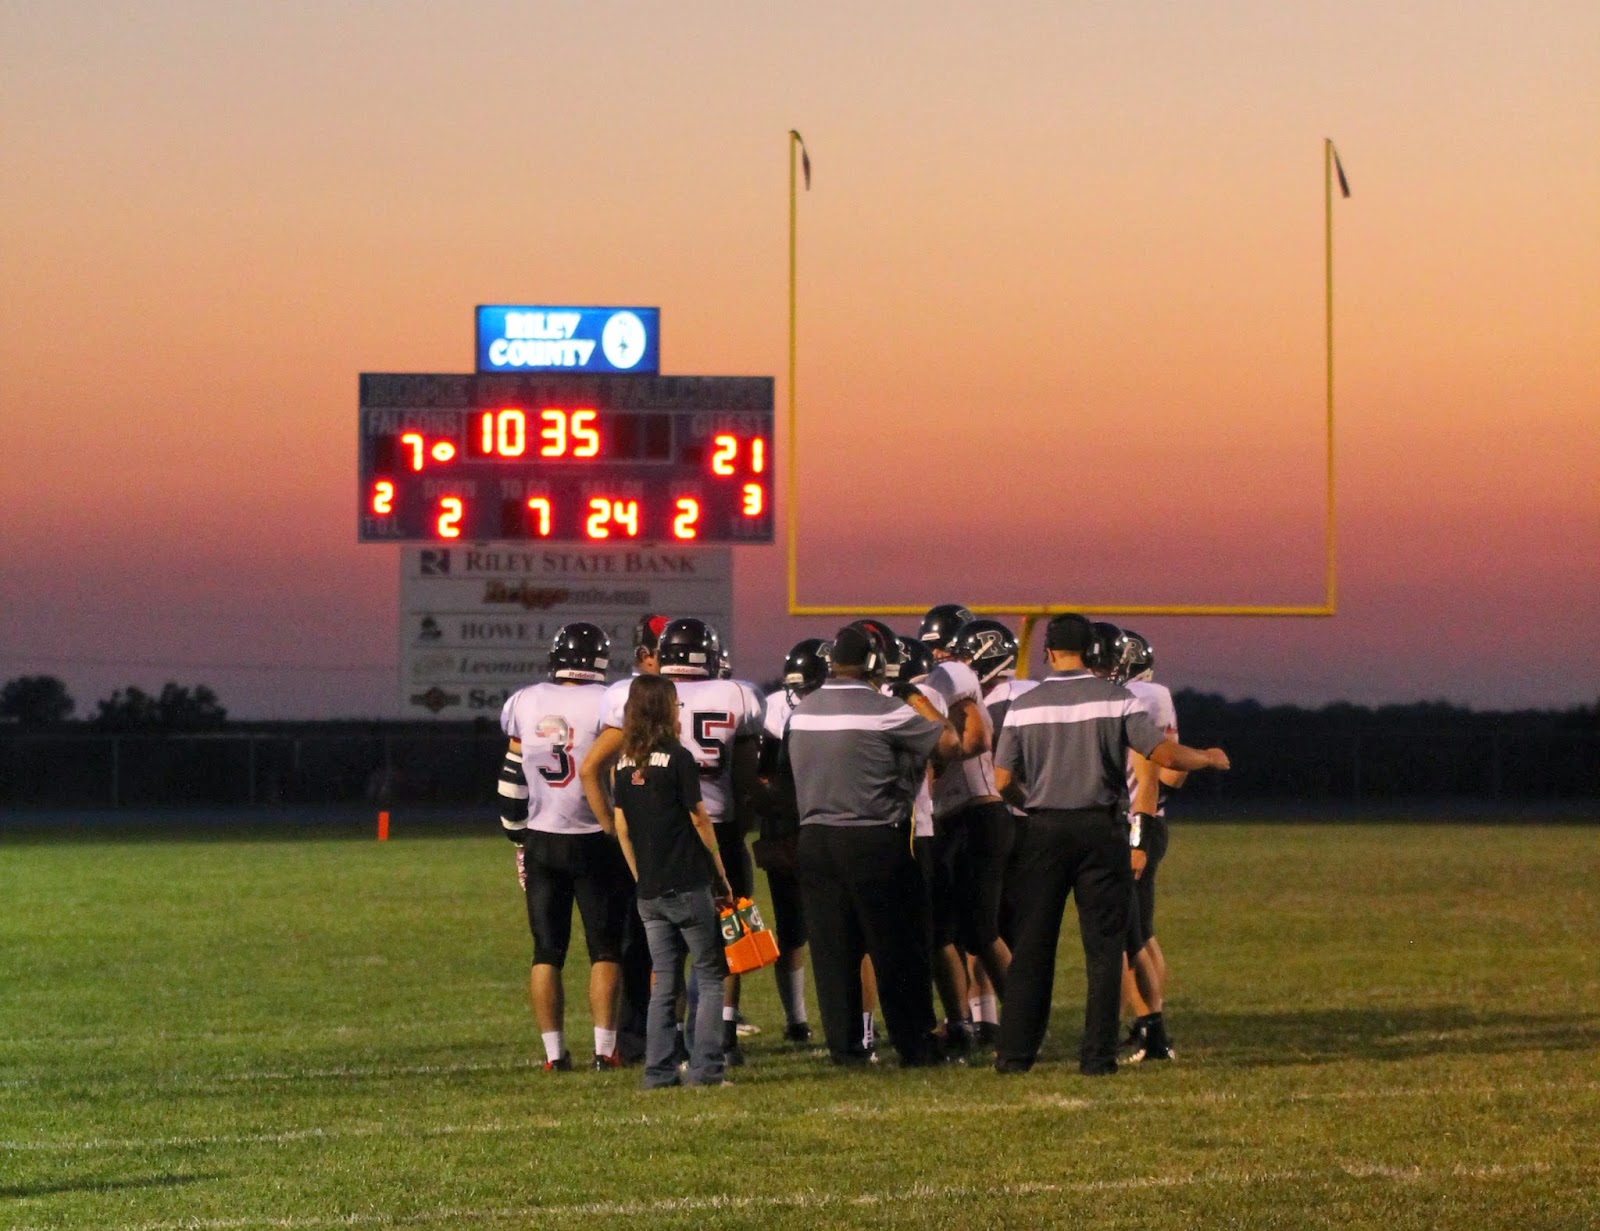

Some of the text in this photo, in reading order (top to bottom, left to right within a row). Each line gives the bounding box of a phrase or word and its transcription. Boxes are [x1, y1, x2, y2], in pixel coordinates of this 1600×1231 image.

[504, 311, 582, 339] RILEY
[489, 338, 597, 367] COUNTY
[712, 434, 763, 476] 21
[373, 481, 395, 514] 2
[437, 497, 463, 539] 2
[528, 497, 551, 537] 7
[586, 497, 638, 539] 24
[673, 497, 699, 540] 2
[742, 482, 763, 516] 3
[535, 714, 576, 788] 3
[675, 711, 735, 772] 5
